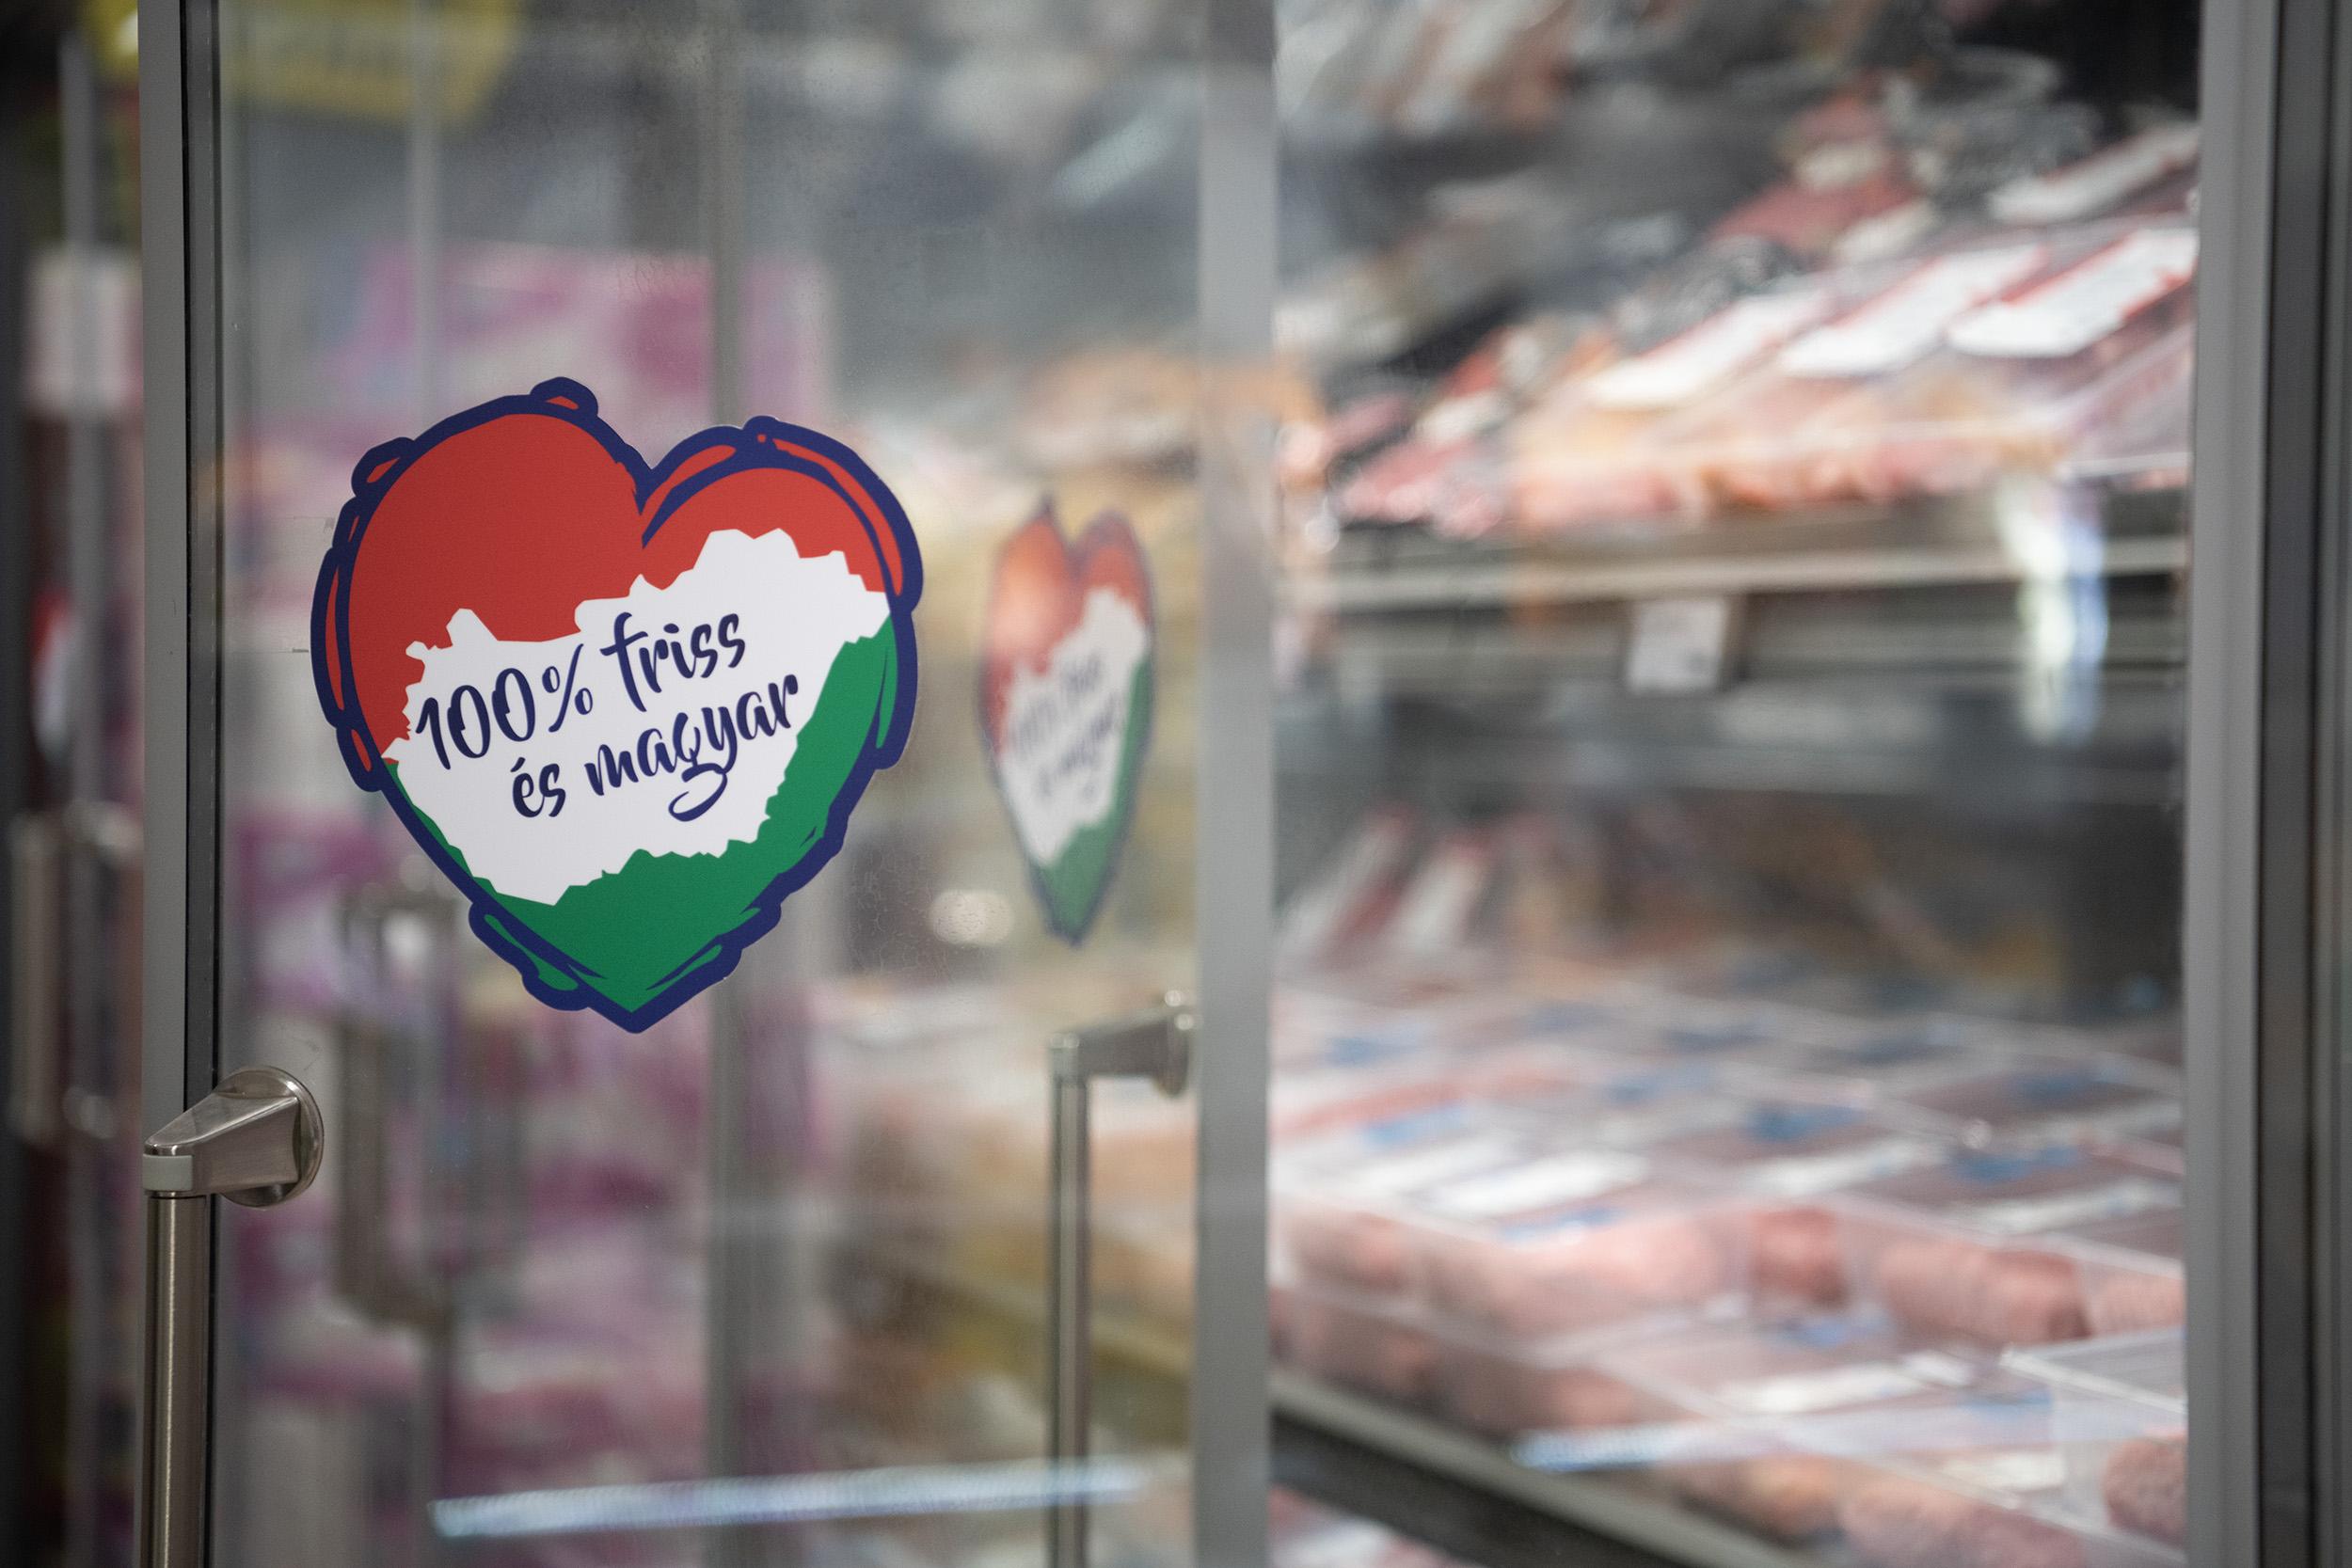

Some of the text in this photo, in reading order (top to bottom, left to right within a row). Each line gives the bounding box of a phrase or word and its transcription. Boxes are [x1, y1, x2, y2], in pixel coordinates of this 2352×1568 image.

[415, 611, 746, 770] 100% friss
[510, 673, 800, 822] és magyar
